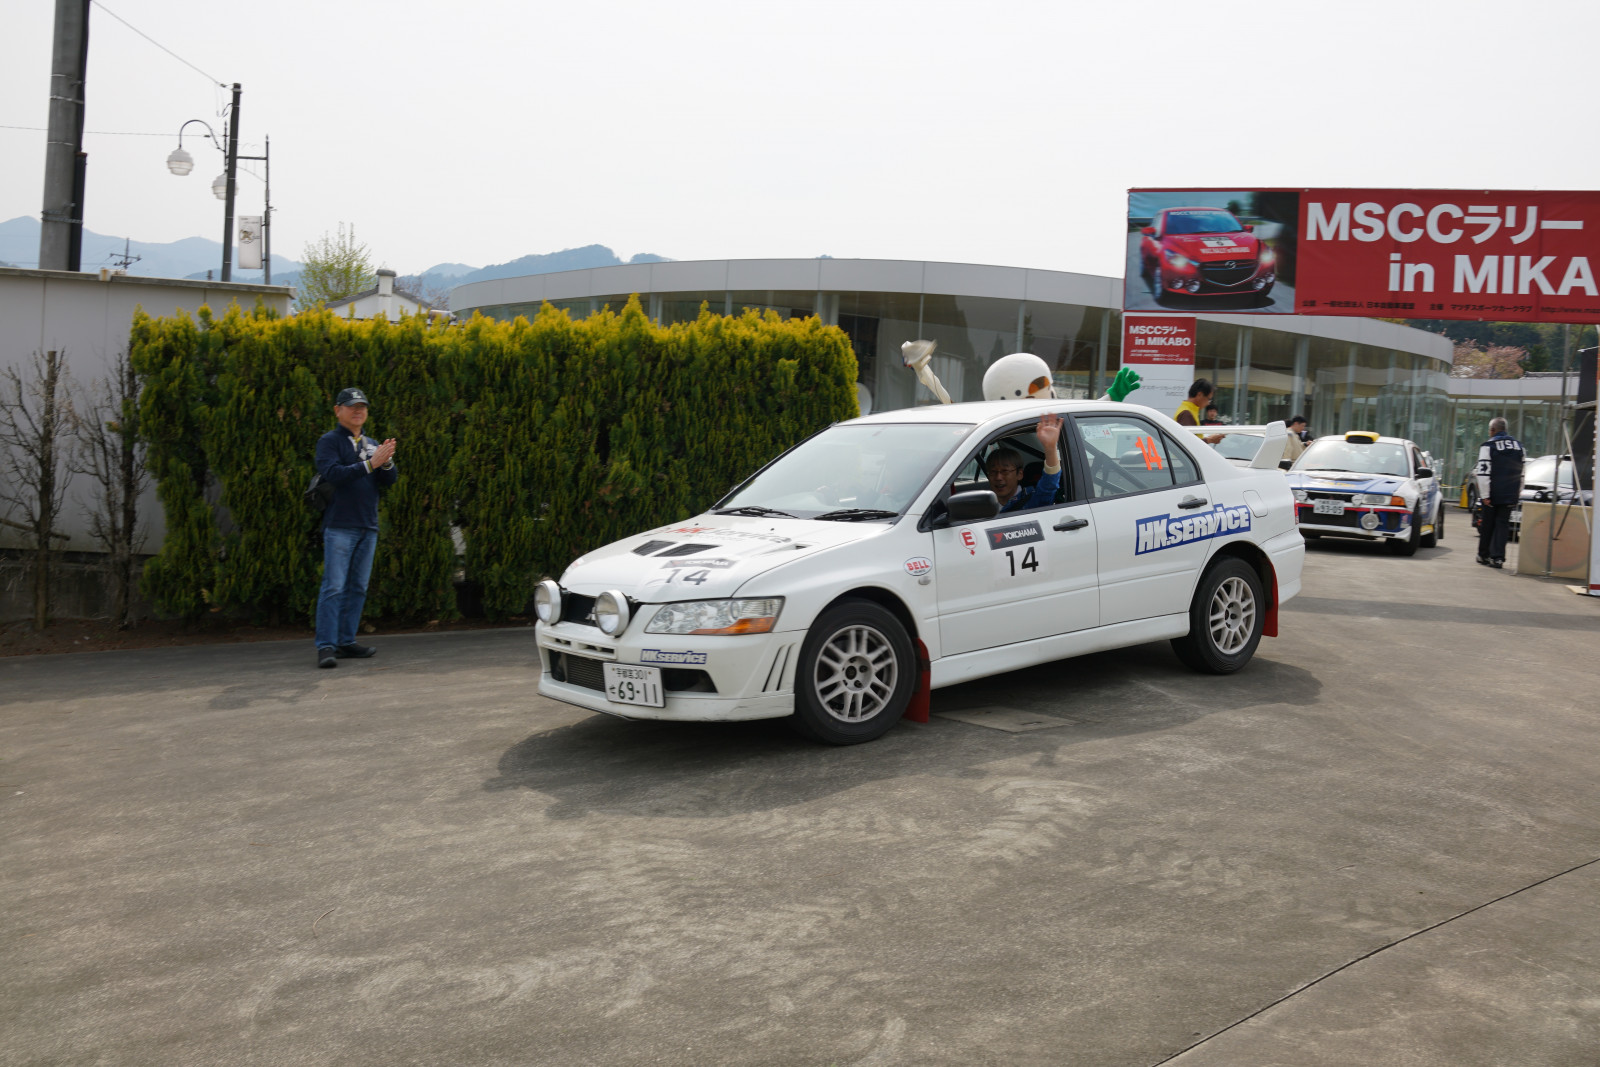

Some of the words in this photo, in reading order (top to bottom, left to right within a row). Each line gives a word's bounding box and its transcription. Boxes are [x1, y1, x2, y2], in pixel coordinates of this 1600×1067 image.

[1306, 202, 1584, 245] MSCCラリー
[1388, 253, 1435, 292] in
[1129, 325, 1187, 335] MSCCラリー
[1135, 336, 1145, 346] in
[1147, 336, 1191, 346] MIKABO
[1135, 436, 1163, 471] 14
[1495, 440, 1521, 451] USA
[961, 531, 975, 547] E
[1002, 528, 1038, 541] YOKOHAMA
[906, 560, 930, 571] BELL
[1005, 546, 1039, 577] 14
[665, 569, 711, 586] 14
